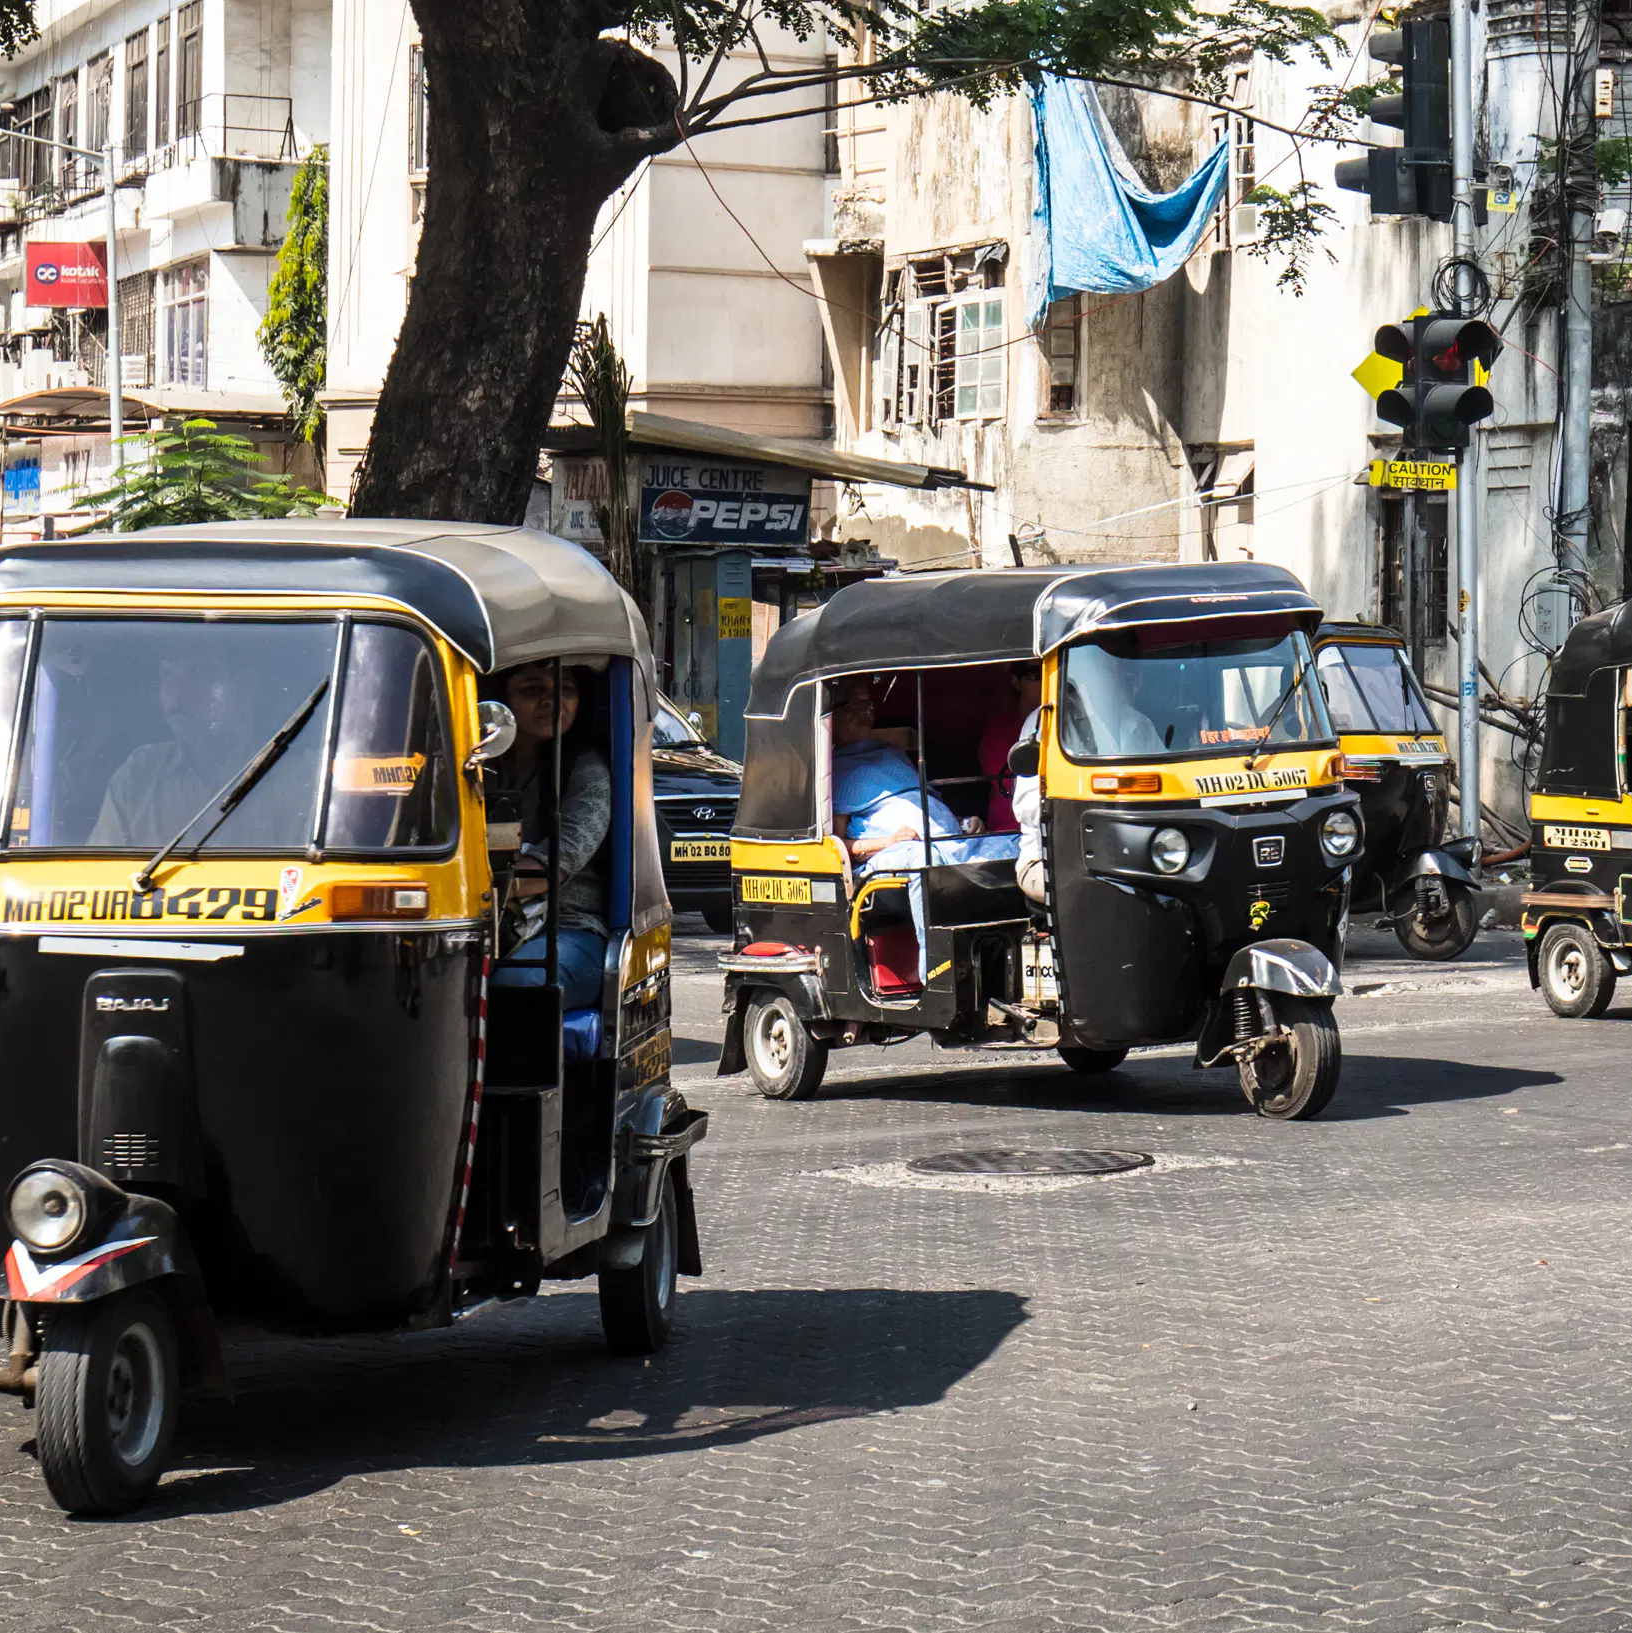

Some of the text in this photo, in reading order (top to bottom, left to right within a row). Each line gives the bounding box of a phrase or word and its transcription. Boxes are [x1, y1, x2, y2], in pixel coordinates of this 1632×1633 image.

[60, 264, 100, 277] kotak
[1389, 462, 1451, 476] CAUTION
[645, 465, 765, 491] JUICE CENTRE
[1392, 476, 1445, 489] सावधान
[686, 499, 805, 531] PEPSI
[1195, 768, 1309, 795] MH 02 DU 5067
[1553, 827, 1603, 839] MH 02
[1569, 838, 1607, 850] 2501
[674, 846, 688, 858] MH
[691, 845, 702, 857] 02
[704, 845, 717, 857] BQ
[744, 879, 808, 901] MH 02 DU 5067
[96, 997, 170, 1011] BAJAJ
